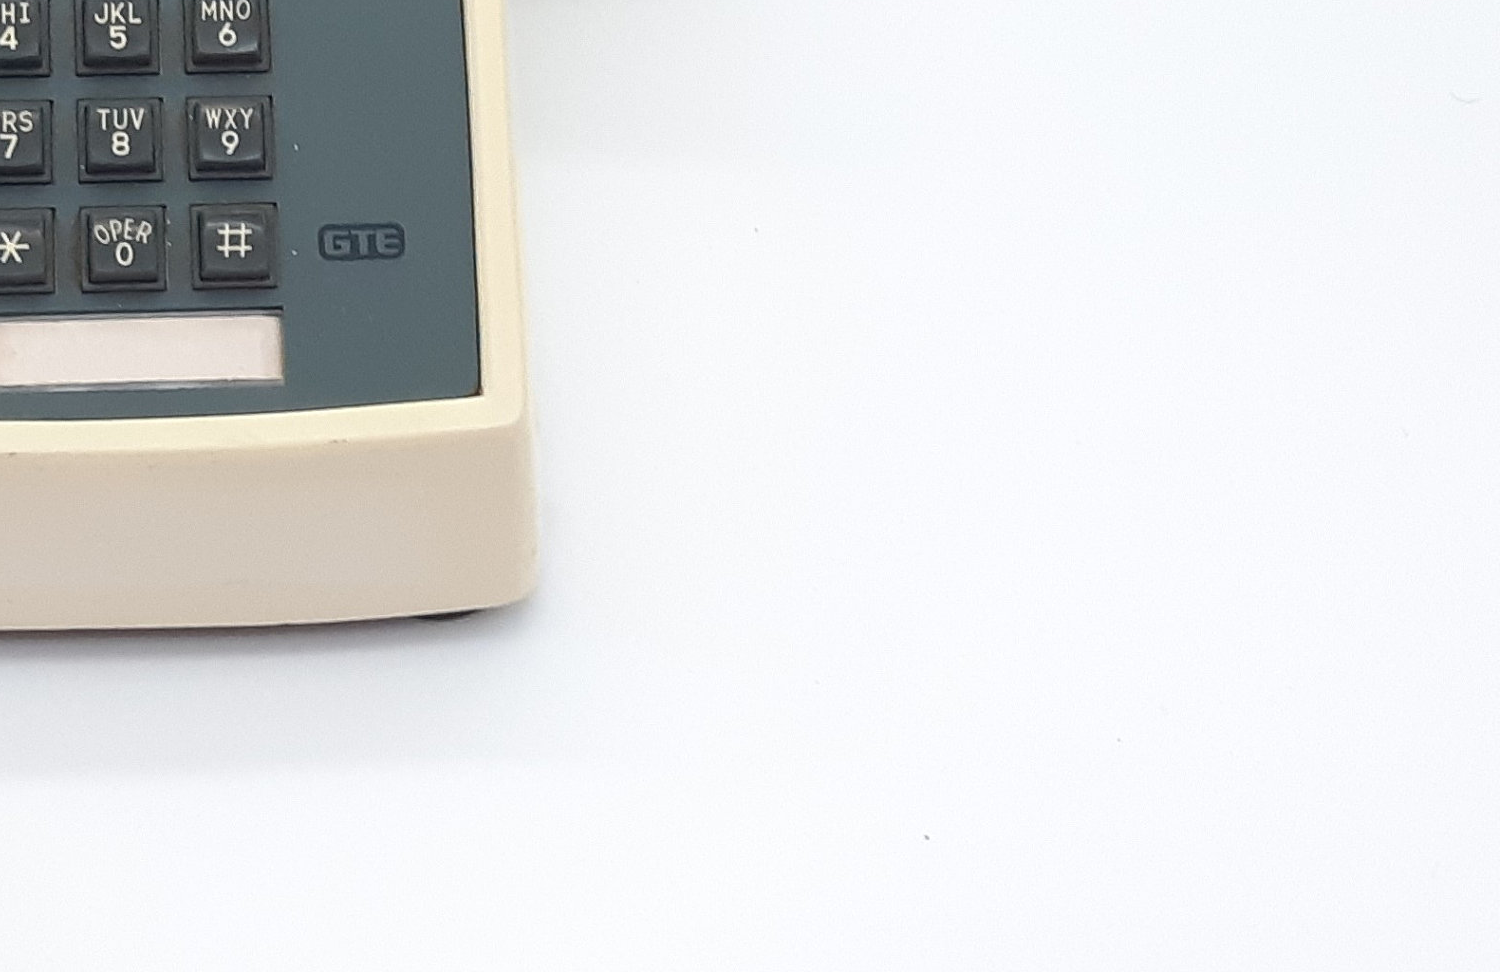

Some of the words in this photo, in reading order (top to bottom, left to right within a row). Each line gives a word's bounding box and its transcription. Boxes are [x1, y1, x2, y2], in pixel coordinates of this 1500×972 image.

[93, 0, 142, 25] JKL
[108, 25, 128, 50] 5
[217, 22, 238, 48] 6
[96, 107, 146, 131] TUV
[204, 107, 254, 131] WXY
[0, 133, 19, 160] 7
[110, 131, 131, 157] 8
[220, 130, 240, 156] 9
[92, 217, 153, 245] OPER
[216, 222, 253, 259] #
[323, 228, 400, 256] GTE
[114, 241, 134, 267] 0
